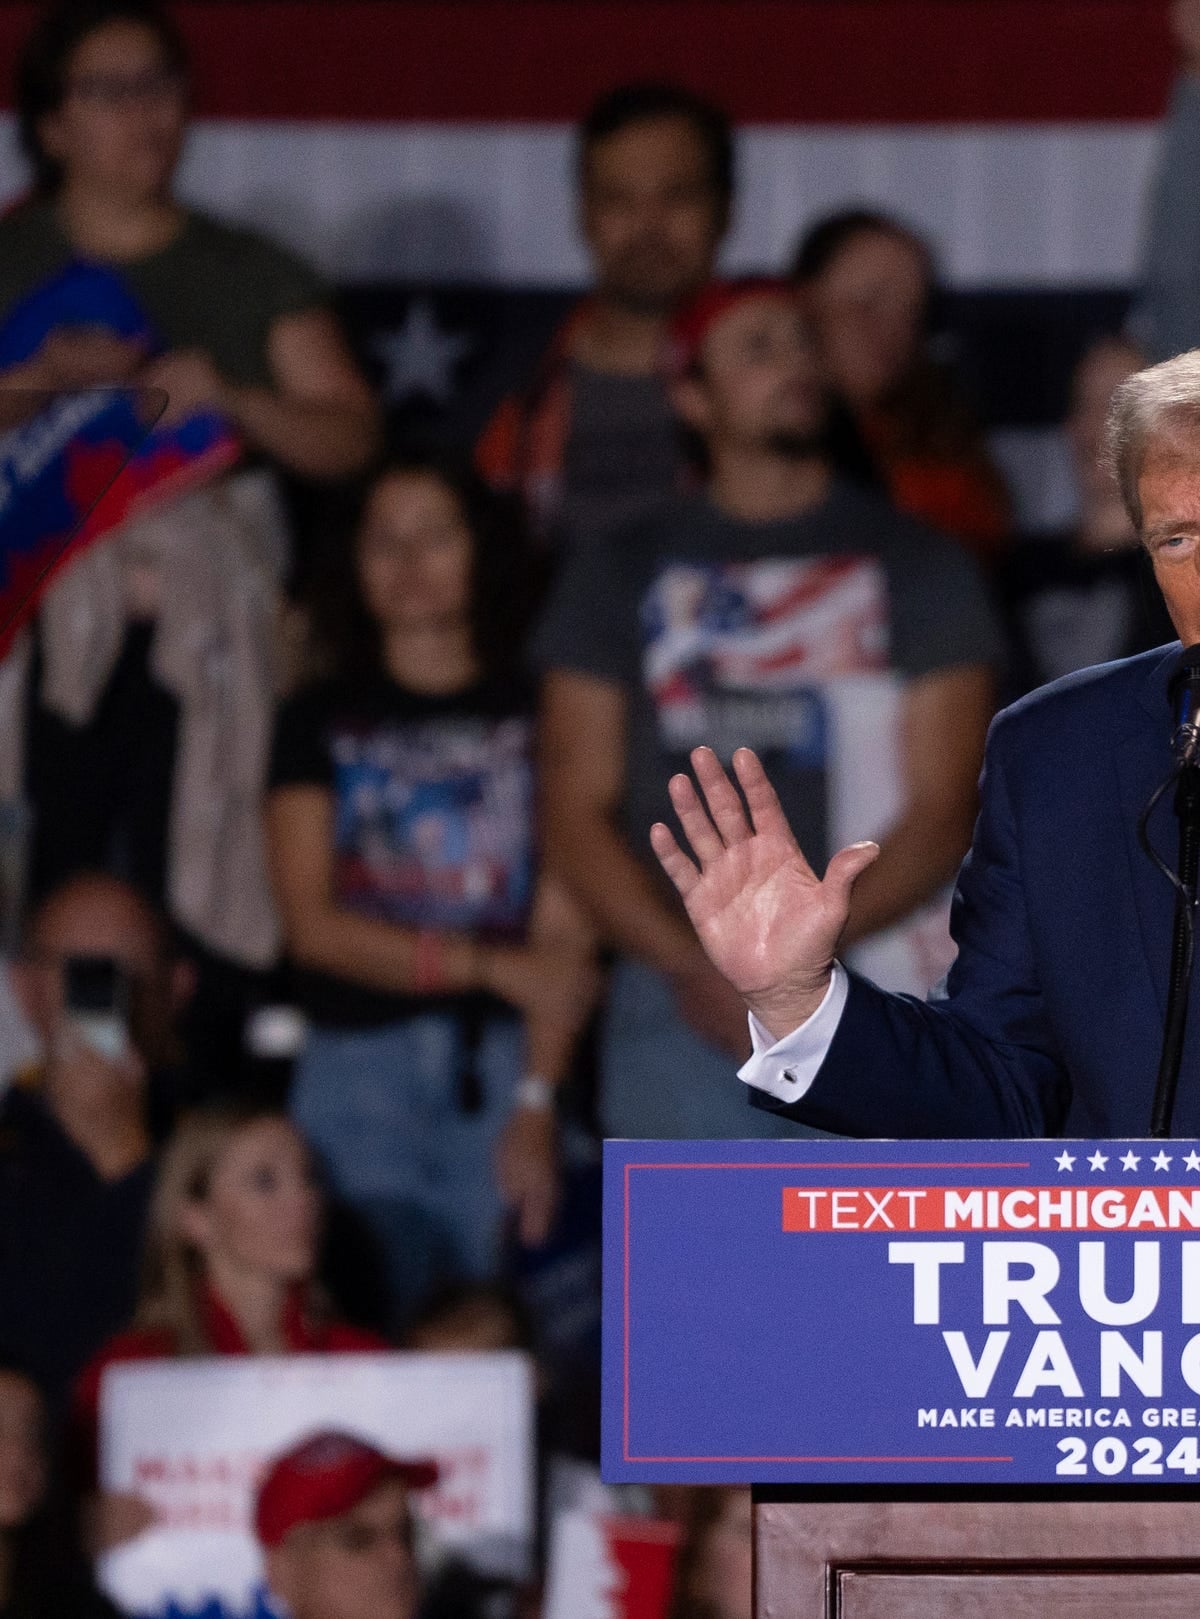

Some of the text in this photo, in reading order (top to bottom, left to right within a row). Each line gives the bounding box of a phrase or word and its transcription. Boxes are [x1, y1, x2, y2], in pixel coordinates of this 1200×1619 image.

[797, 1190, 927, 1229] TEXT
[917, 1408, 996, 1428] MAKE
[1004, 1407, 1132, 1428] AMERICA
